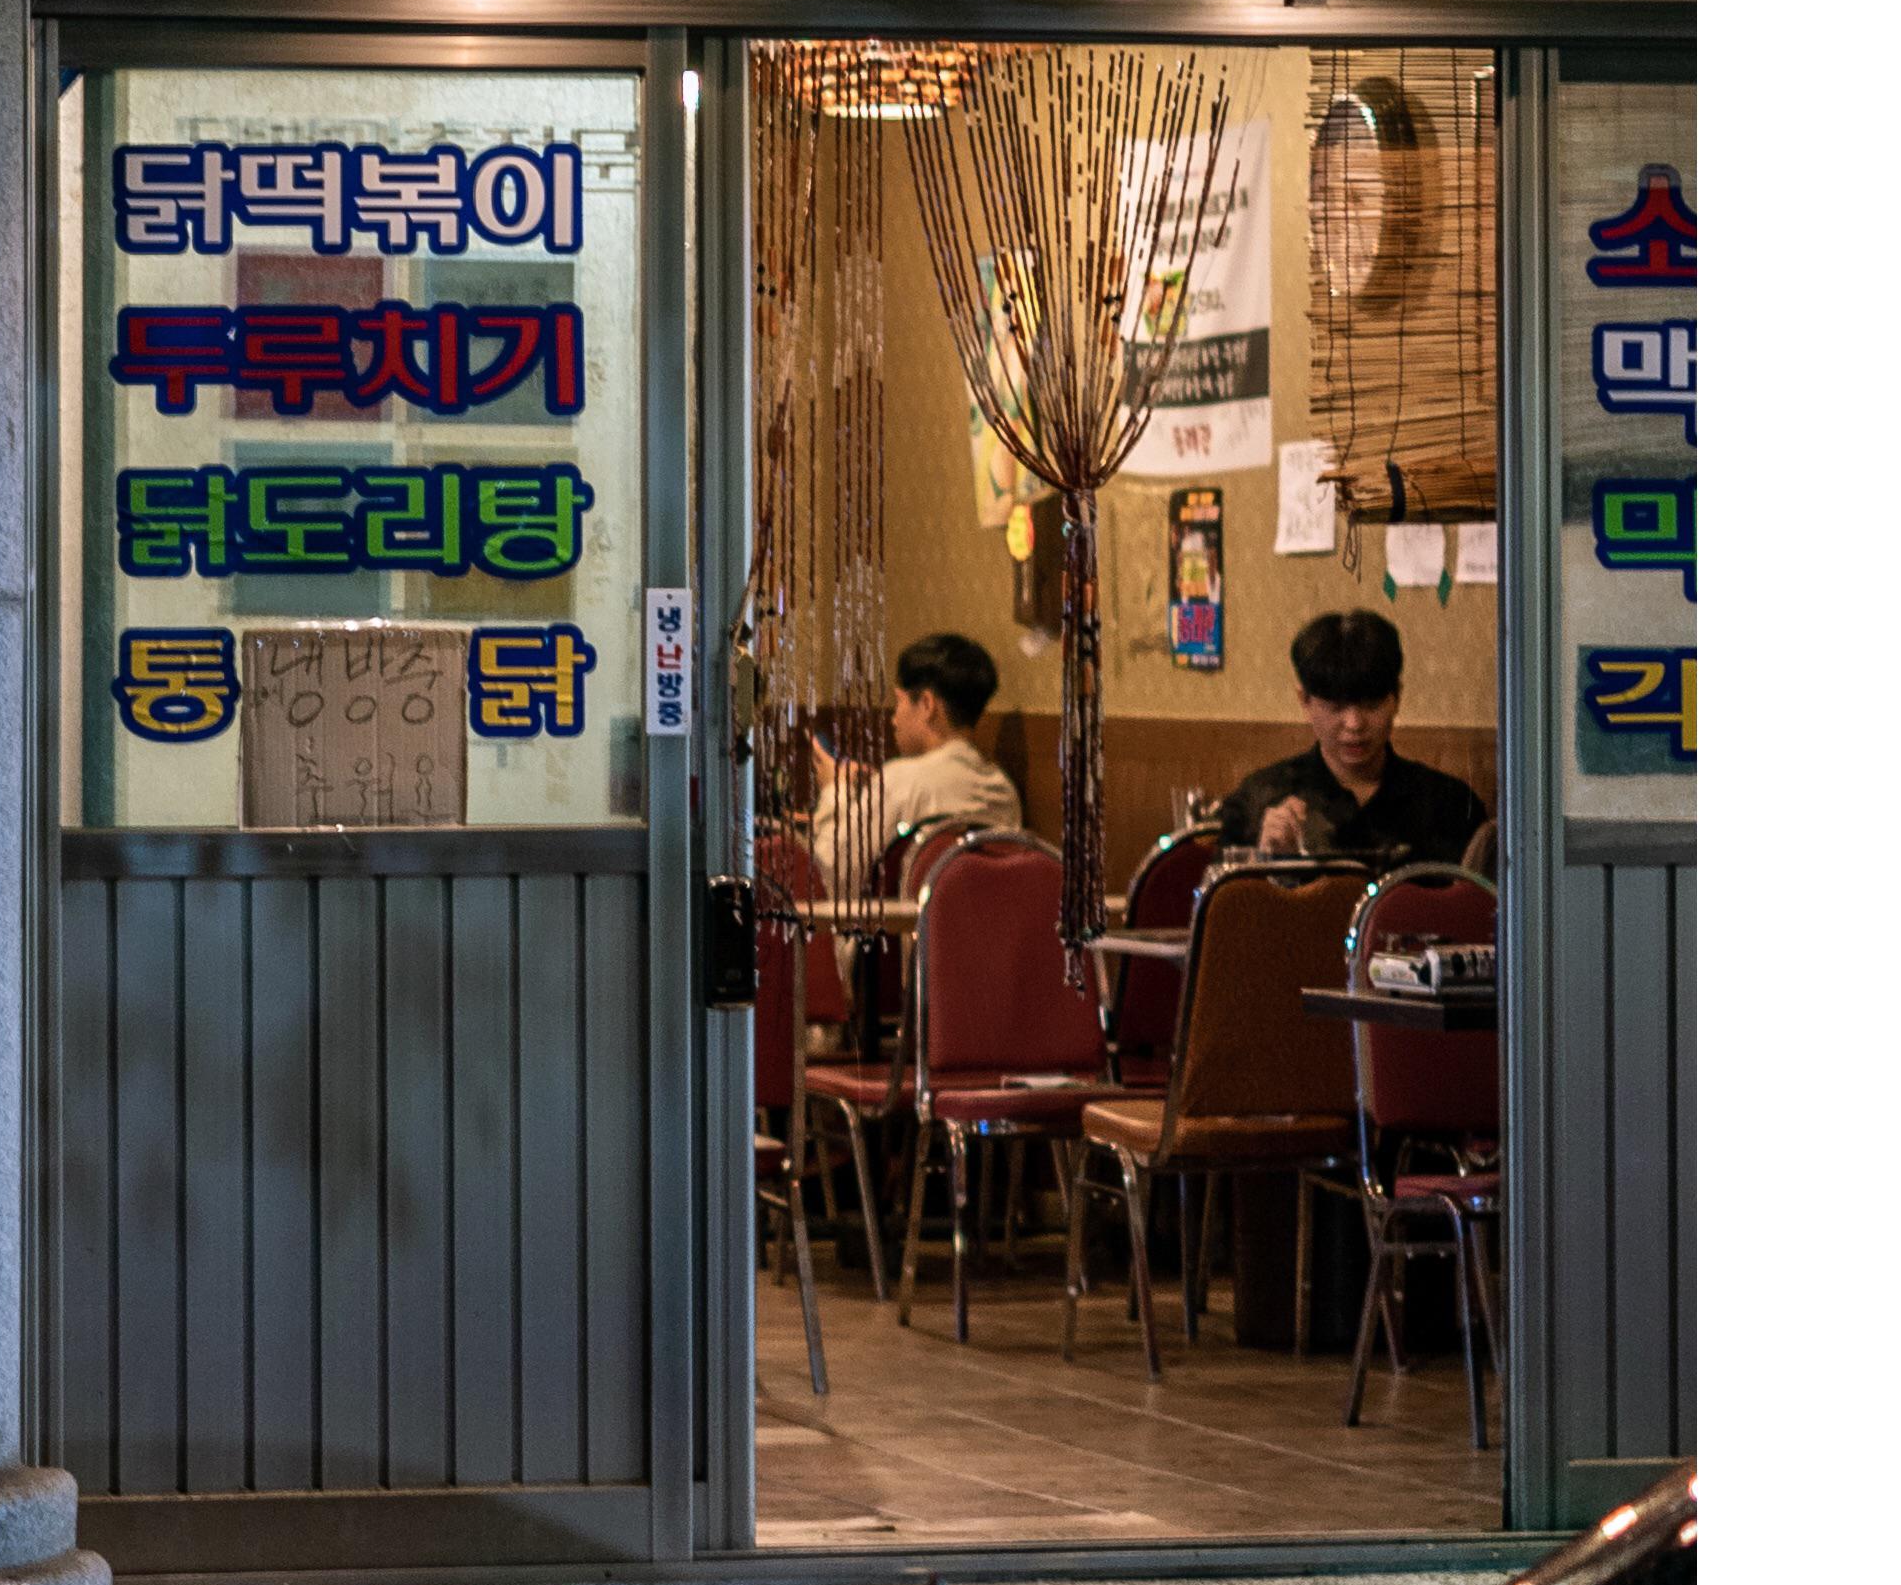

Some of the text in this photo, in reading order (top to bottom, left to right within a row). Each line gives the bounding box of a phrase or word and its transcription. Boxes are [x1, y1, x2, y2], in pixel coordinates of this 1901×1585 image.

[114, 141, 584, 254] 닭떡볶이
[110, 301, 585, 414] 두루치기
[115, 464, 594, 580] 닭도리탕
